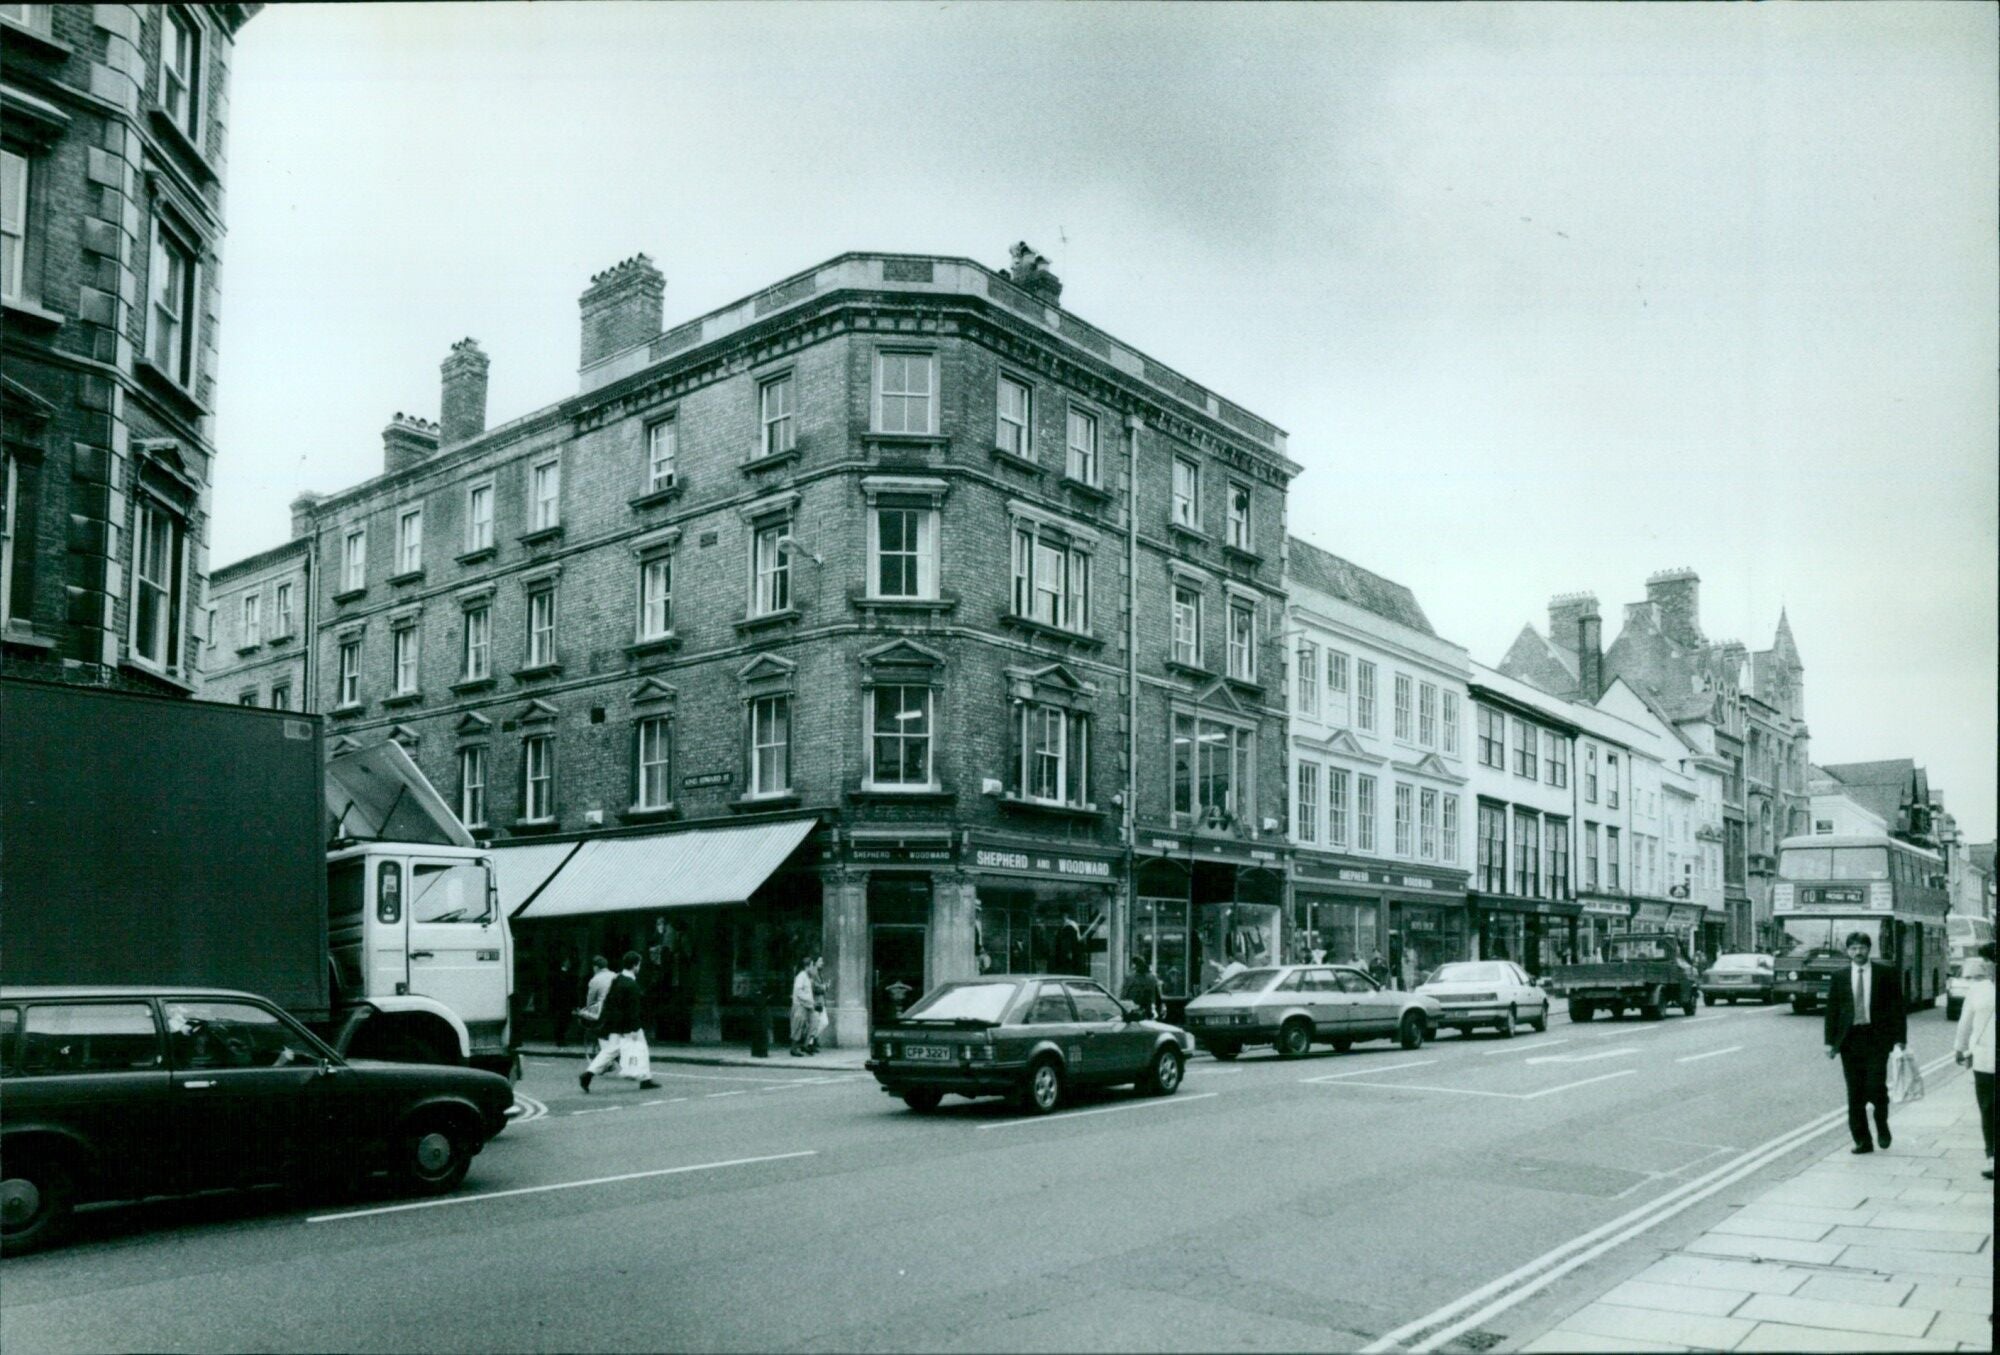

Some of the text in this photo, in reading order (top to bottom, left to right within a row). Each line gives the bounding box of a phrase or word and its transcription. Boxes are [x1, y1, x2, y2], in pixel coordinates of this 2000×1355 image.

[853, 851, 890, 859] SHEPHERD
[909, 851, 950, 859] WOODWARD
[977, 850, 1109, 876] SHEPHERD AND WOODWARD
[1339, 869, 1369, 882] SHEPHERD
[906, 1047, 949, 1058] CFP 322Y
